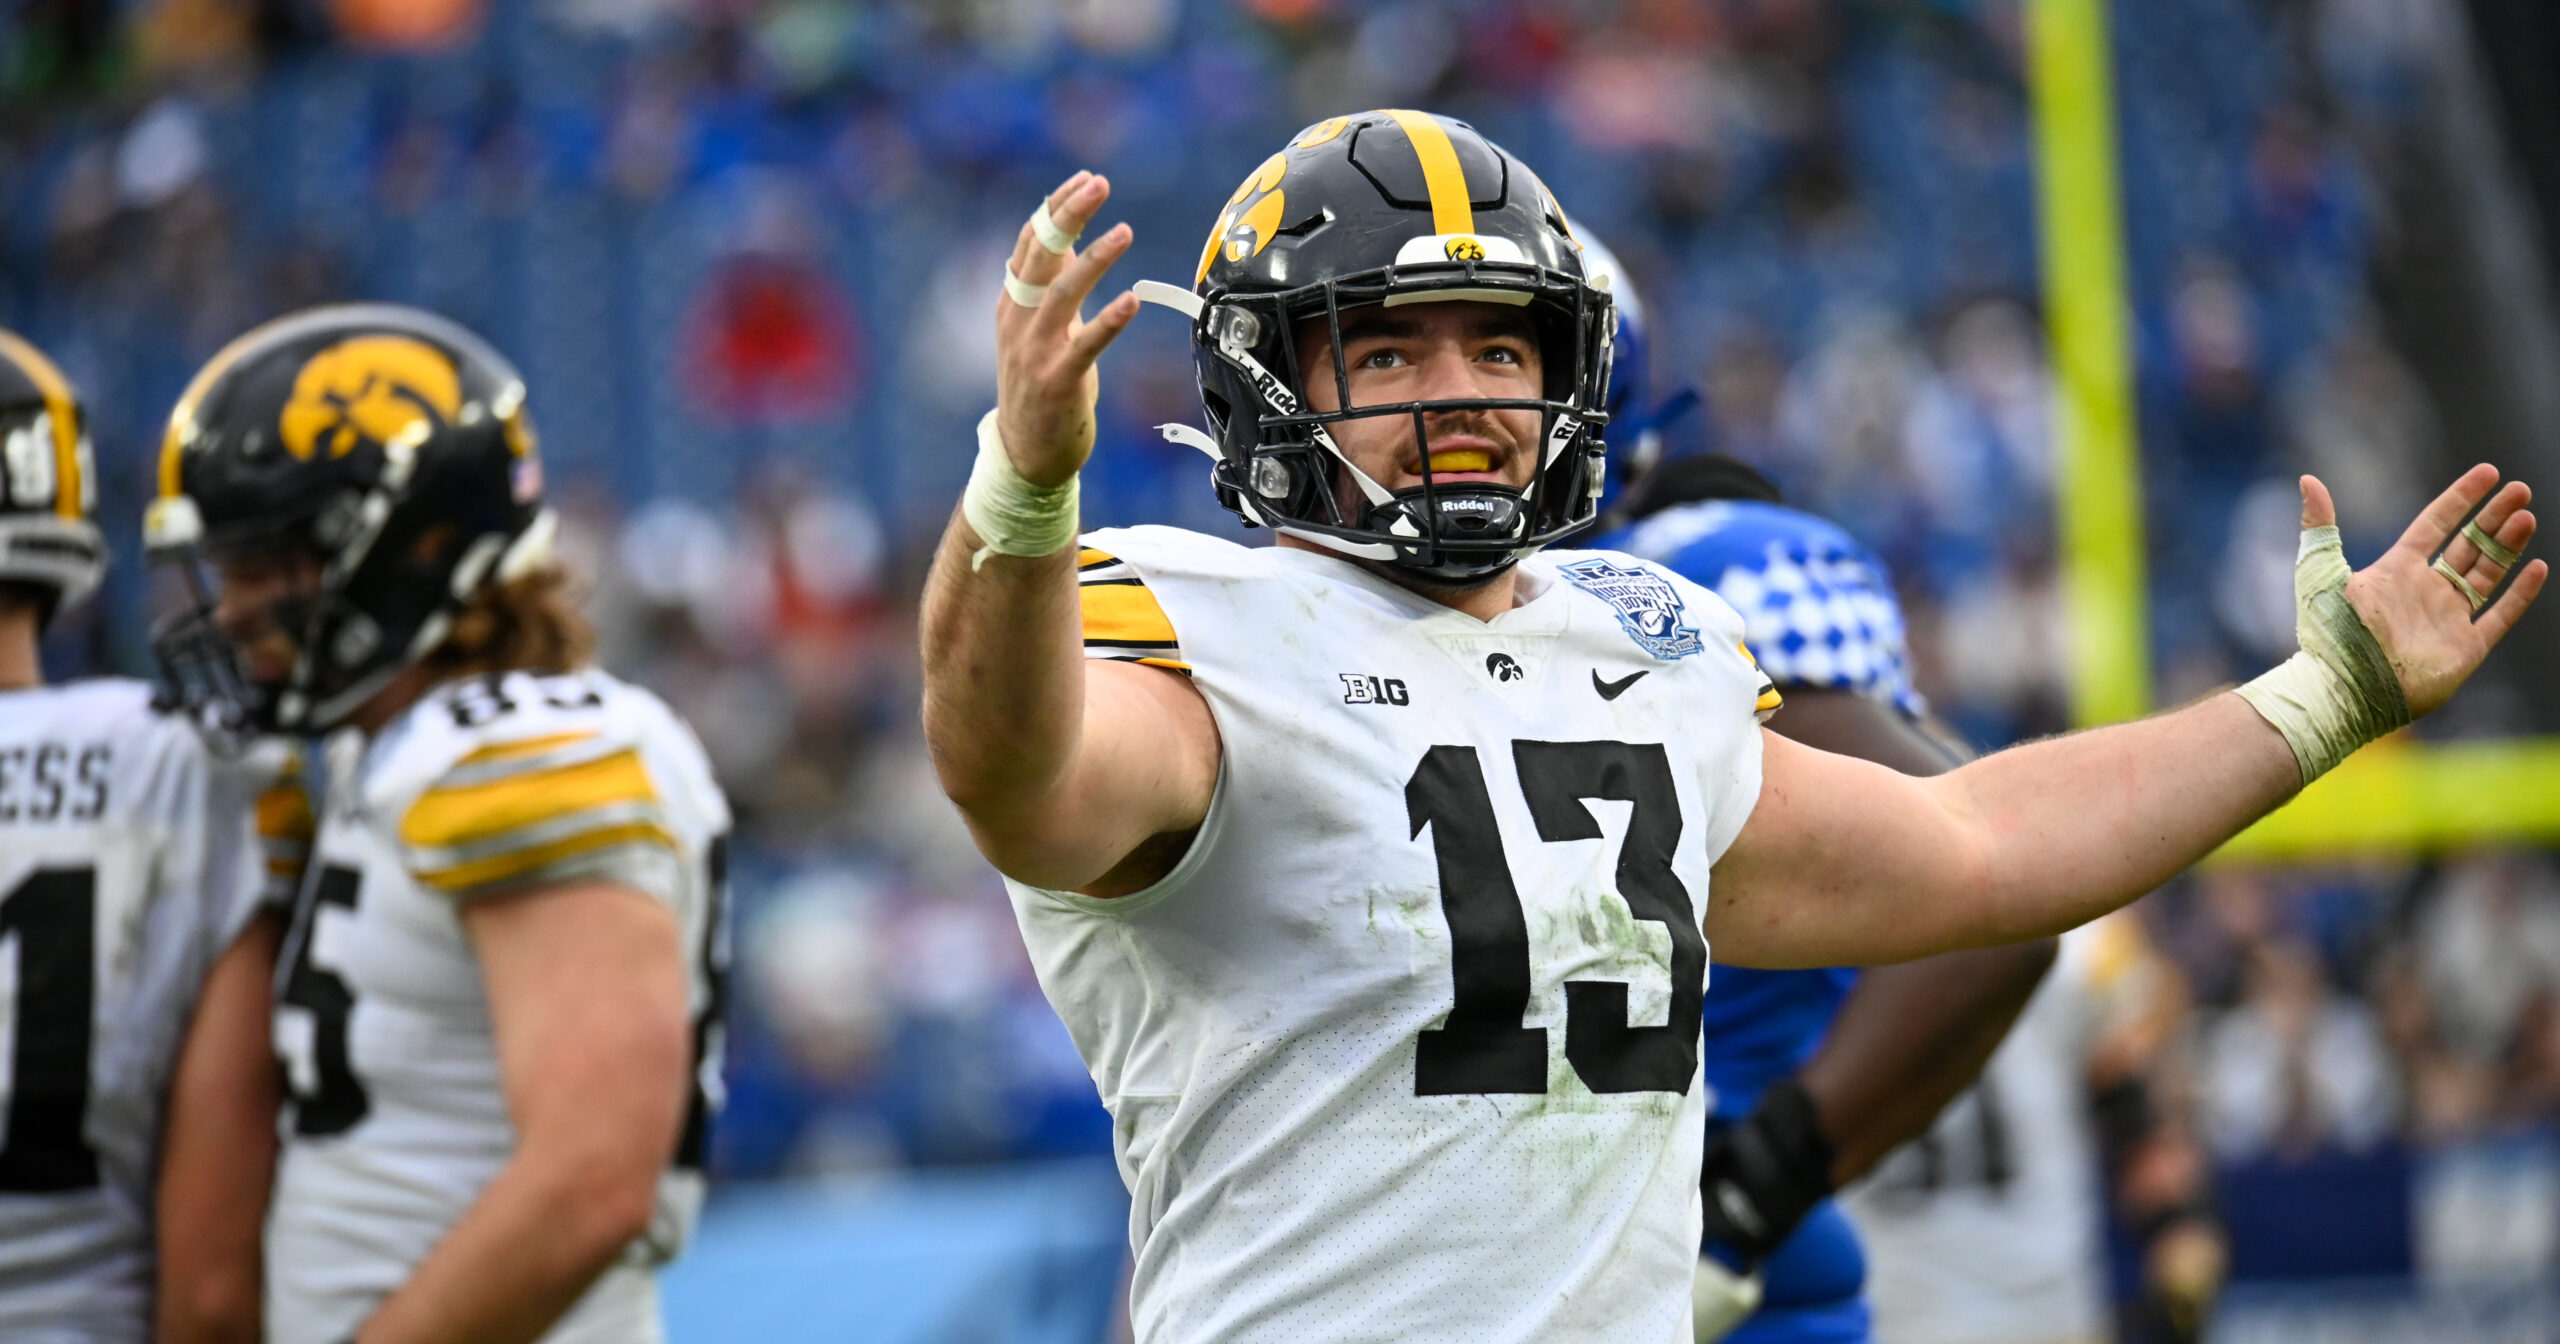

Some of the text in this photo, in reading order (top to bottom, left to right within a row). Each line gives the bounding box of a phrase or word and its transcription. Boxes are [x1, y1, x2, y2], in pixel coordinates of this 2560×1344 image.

[1441, 500, 1494, 512] Riddell
[1635, 585, 1672, 601] CITY
[1404, 738, 1707, 1097] 13
